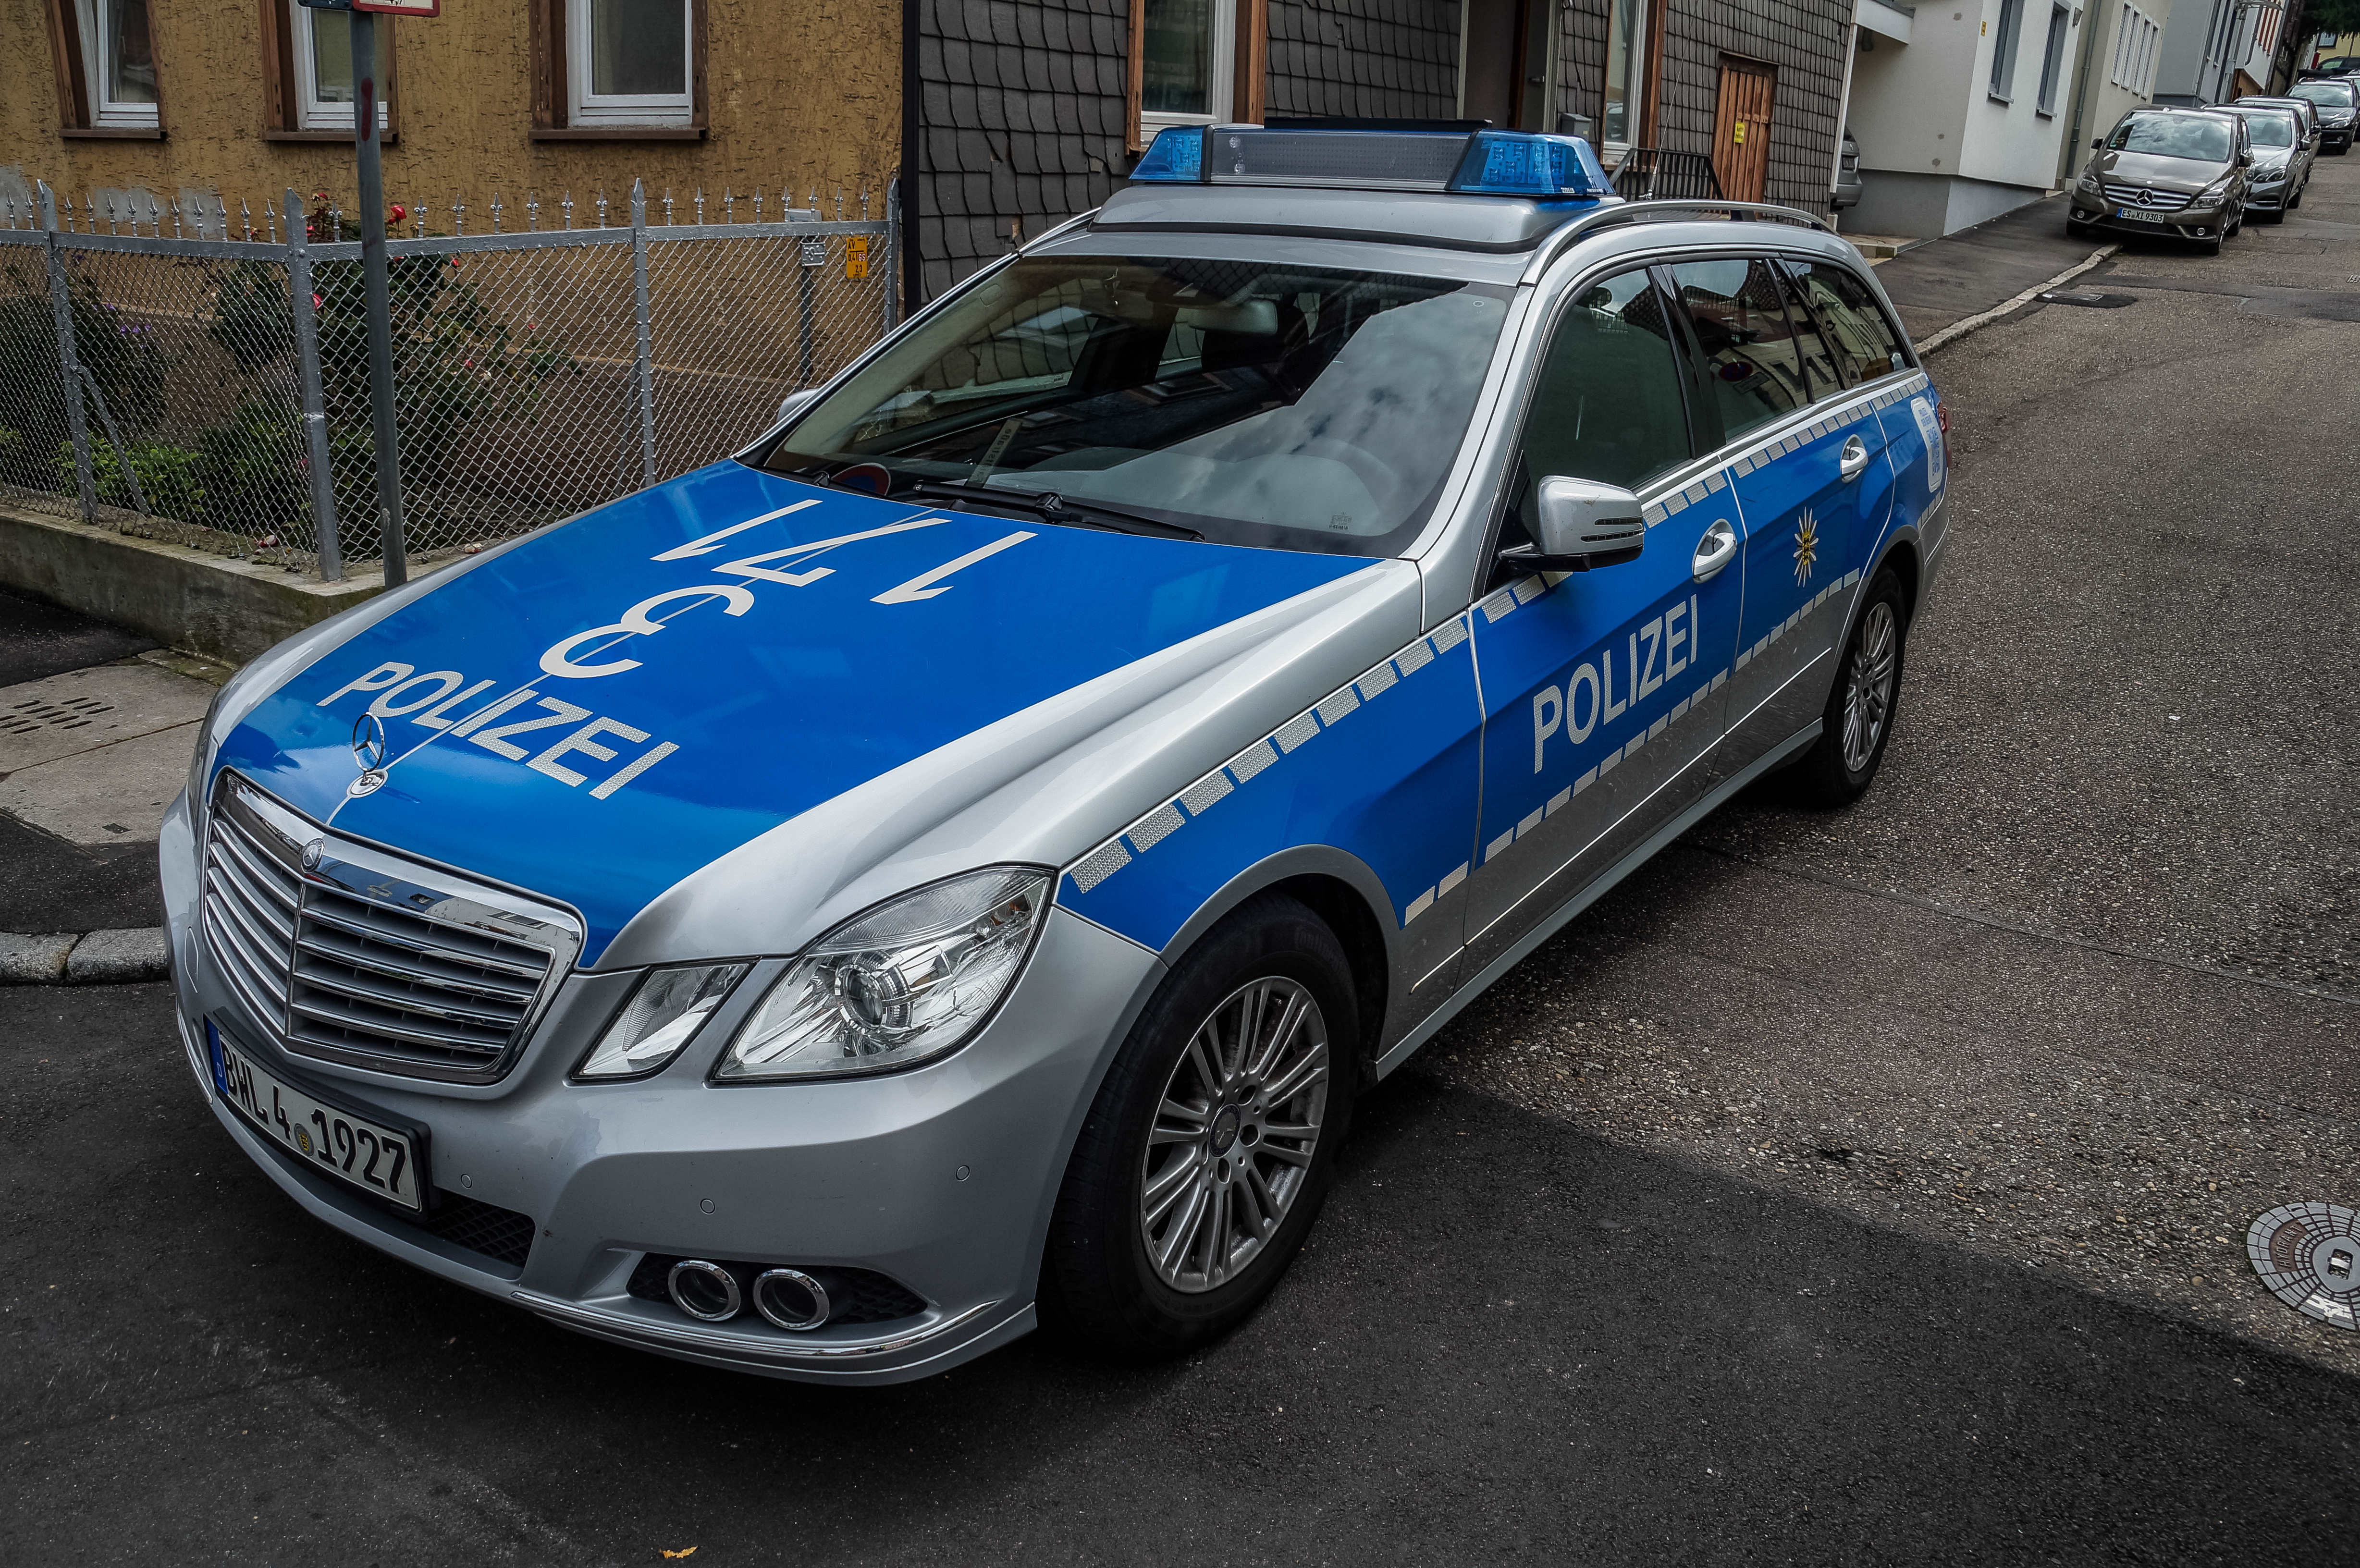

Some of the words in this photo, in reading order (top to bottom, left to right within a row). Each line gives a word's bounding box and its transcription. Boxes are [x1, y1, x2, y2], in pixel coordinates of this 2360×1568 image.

[2122, 209, 2132, 218] ES
[2145, 213, 2164, 222] 9303
[316, 661, 680, 800] POLIZEI
[1533, 594, 1698, 774] POLIZEI
[272, 1084, 292, 1142] 4
[310, 1107, 408, 1195] 1927
[2275, 1225, 2305, 1269] HYDRANT
